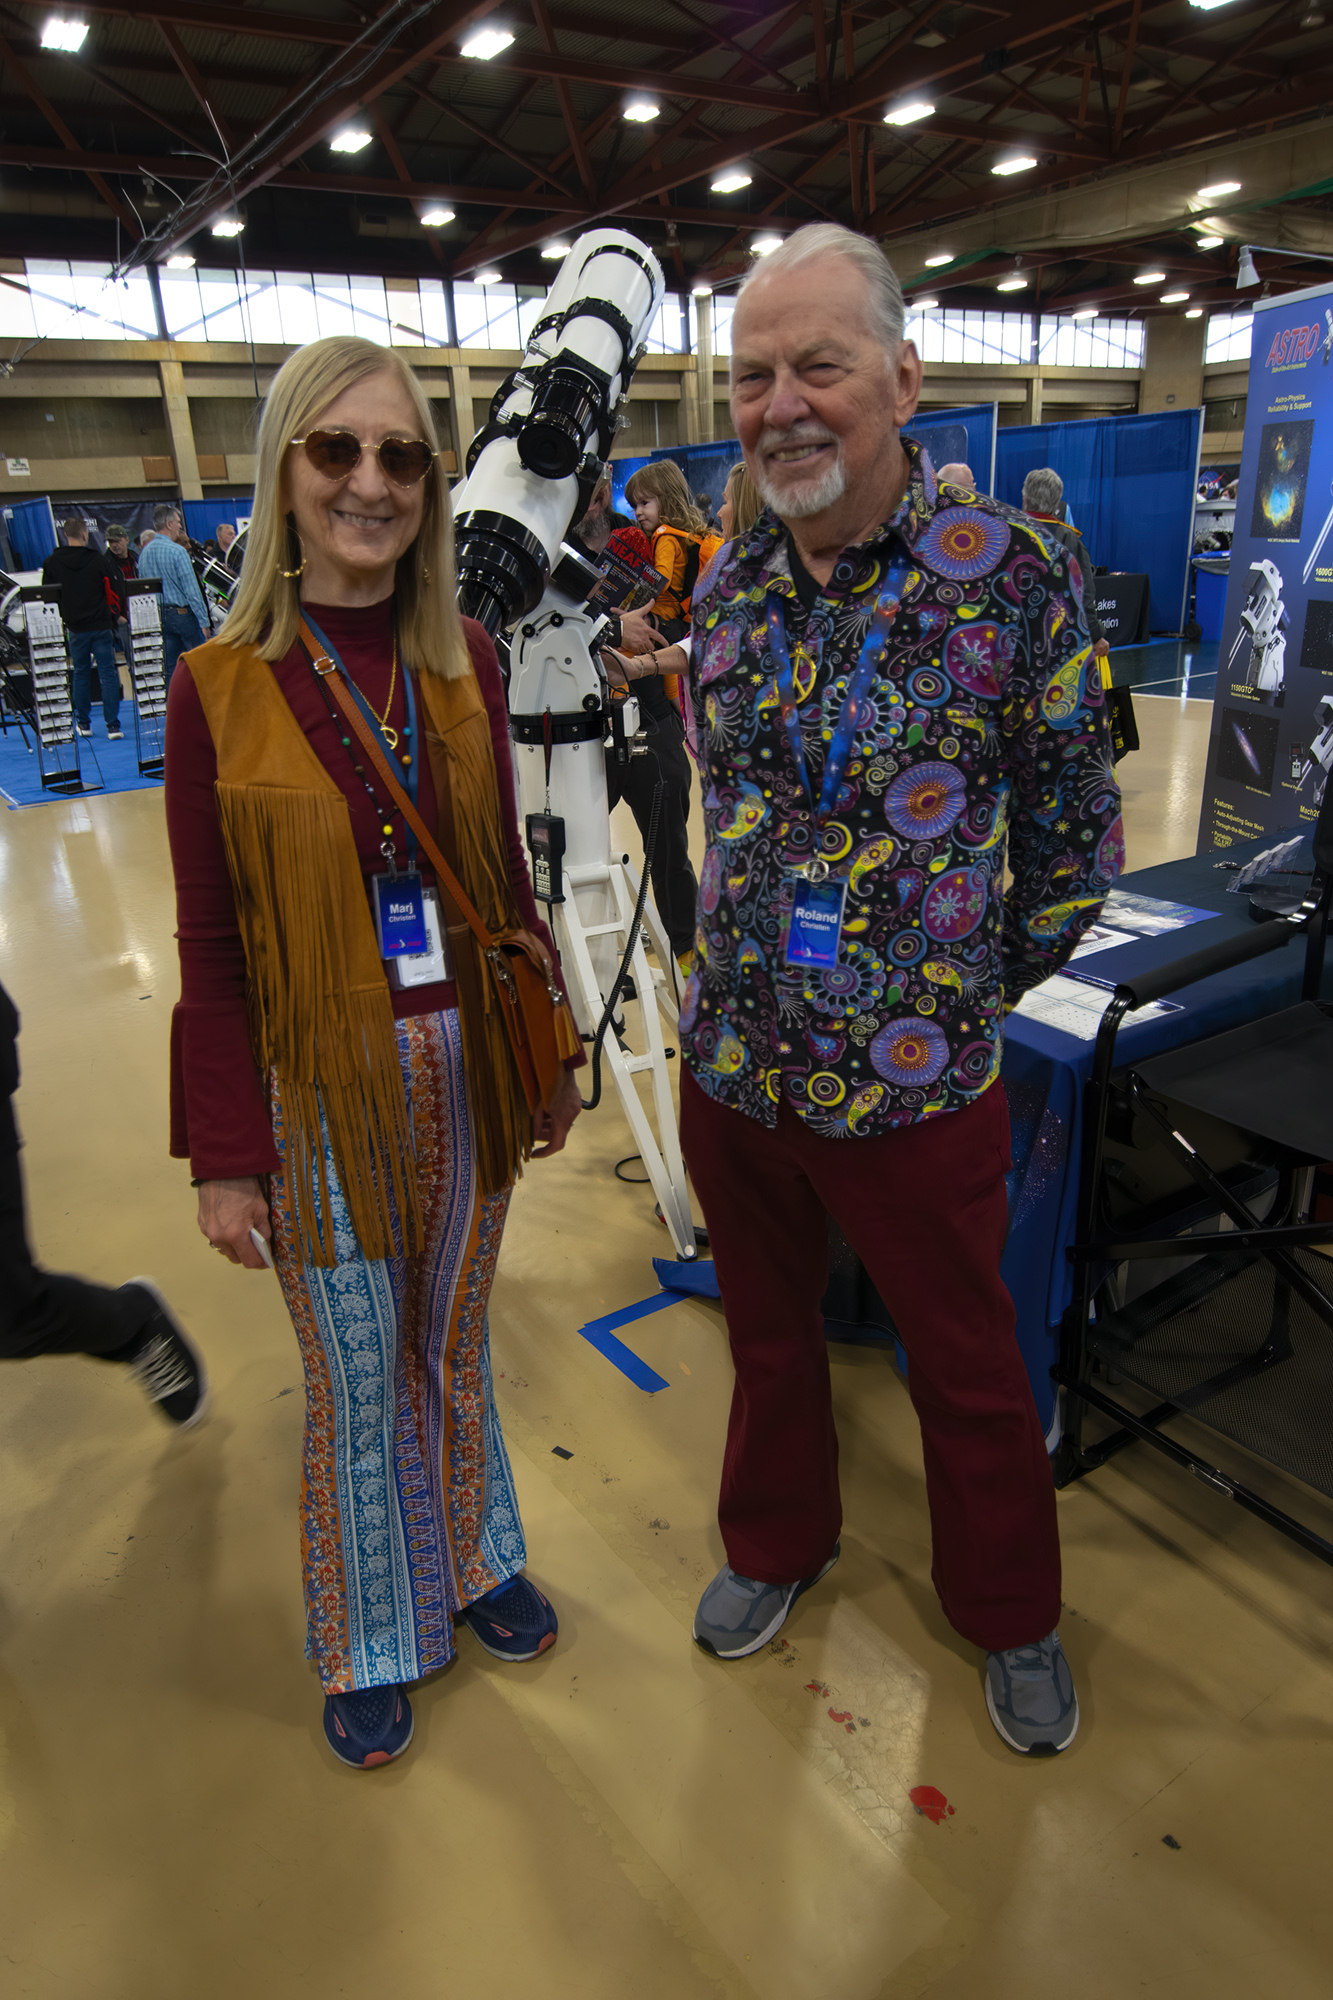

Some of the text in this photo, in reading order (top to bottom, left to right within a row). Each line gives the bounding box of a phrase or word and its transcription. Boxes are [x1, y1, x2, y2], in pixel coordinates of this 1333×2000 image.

[1265, 323, 1319, 367] ASTRO
[1275, 394, 1305, 403] Astro-Physics
[1267, 405, 1289, 413] Reliability
[1294, 401, 1312, 411] Support
[603, 549, 620, 564] OFFICIAL
[607, 537, 643, 568] NEAF
[643, 565, 662, 581] FORUM
[390, 903, 413, 914] Marj
[795, 907, 838, 923] Roland
[389, 914, 416, 923] Christen
